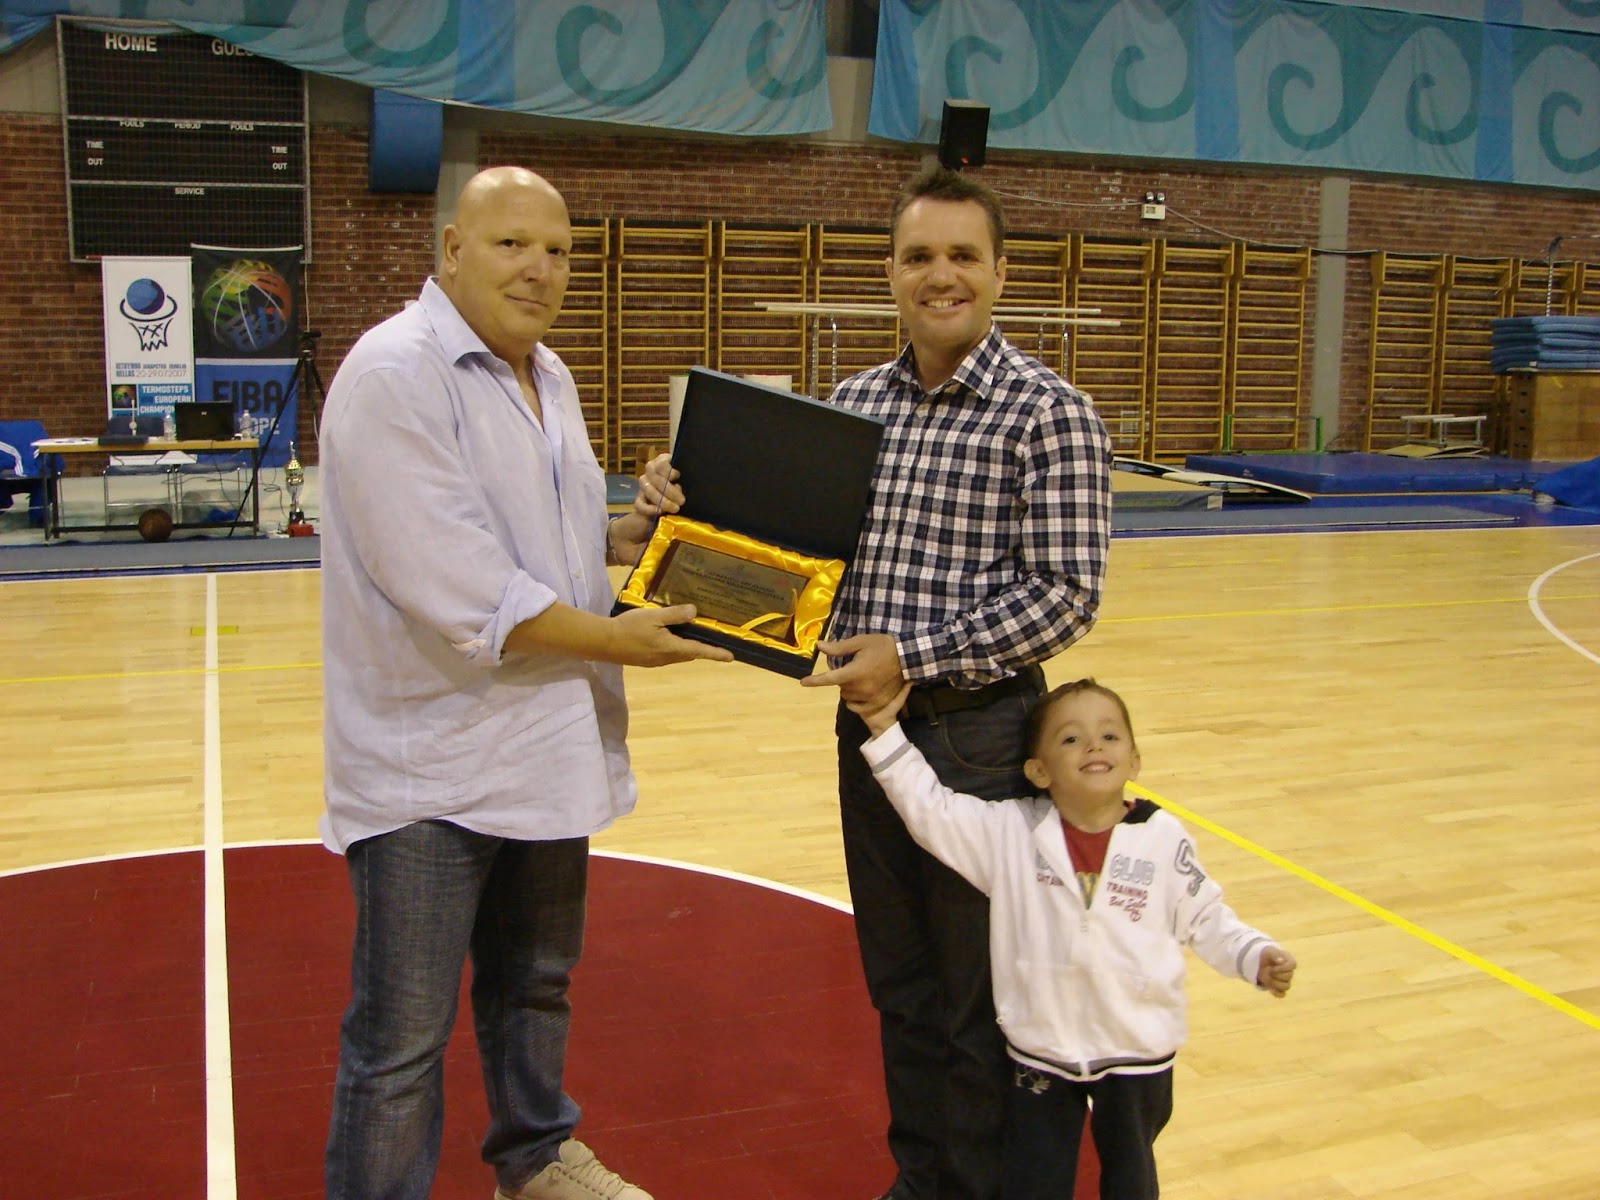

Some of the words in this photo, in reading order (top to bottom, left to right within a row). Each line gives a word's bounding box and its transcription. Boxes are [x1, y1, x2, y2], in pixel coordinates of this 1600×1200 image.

[105, 33, 157, 52] HOME
[120, 120, 145, 128] FOULS
[174, 121, 201, 130] PERIOD
[230, 122, 255, 131] FOULS
[86, 140, 104, 149] TIME
[271, 145, 288, 154] TIME
[87, 158, 104, 166] OUT
[272, 162, 288, 170] OUT
[174, 187, 205, 195] SERVICE
[142, 385, 189, 394] TERMOSTEPS
[154, 395, 192, 403] EUROPEAN
[213, 381, 284, 413] FIBA
